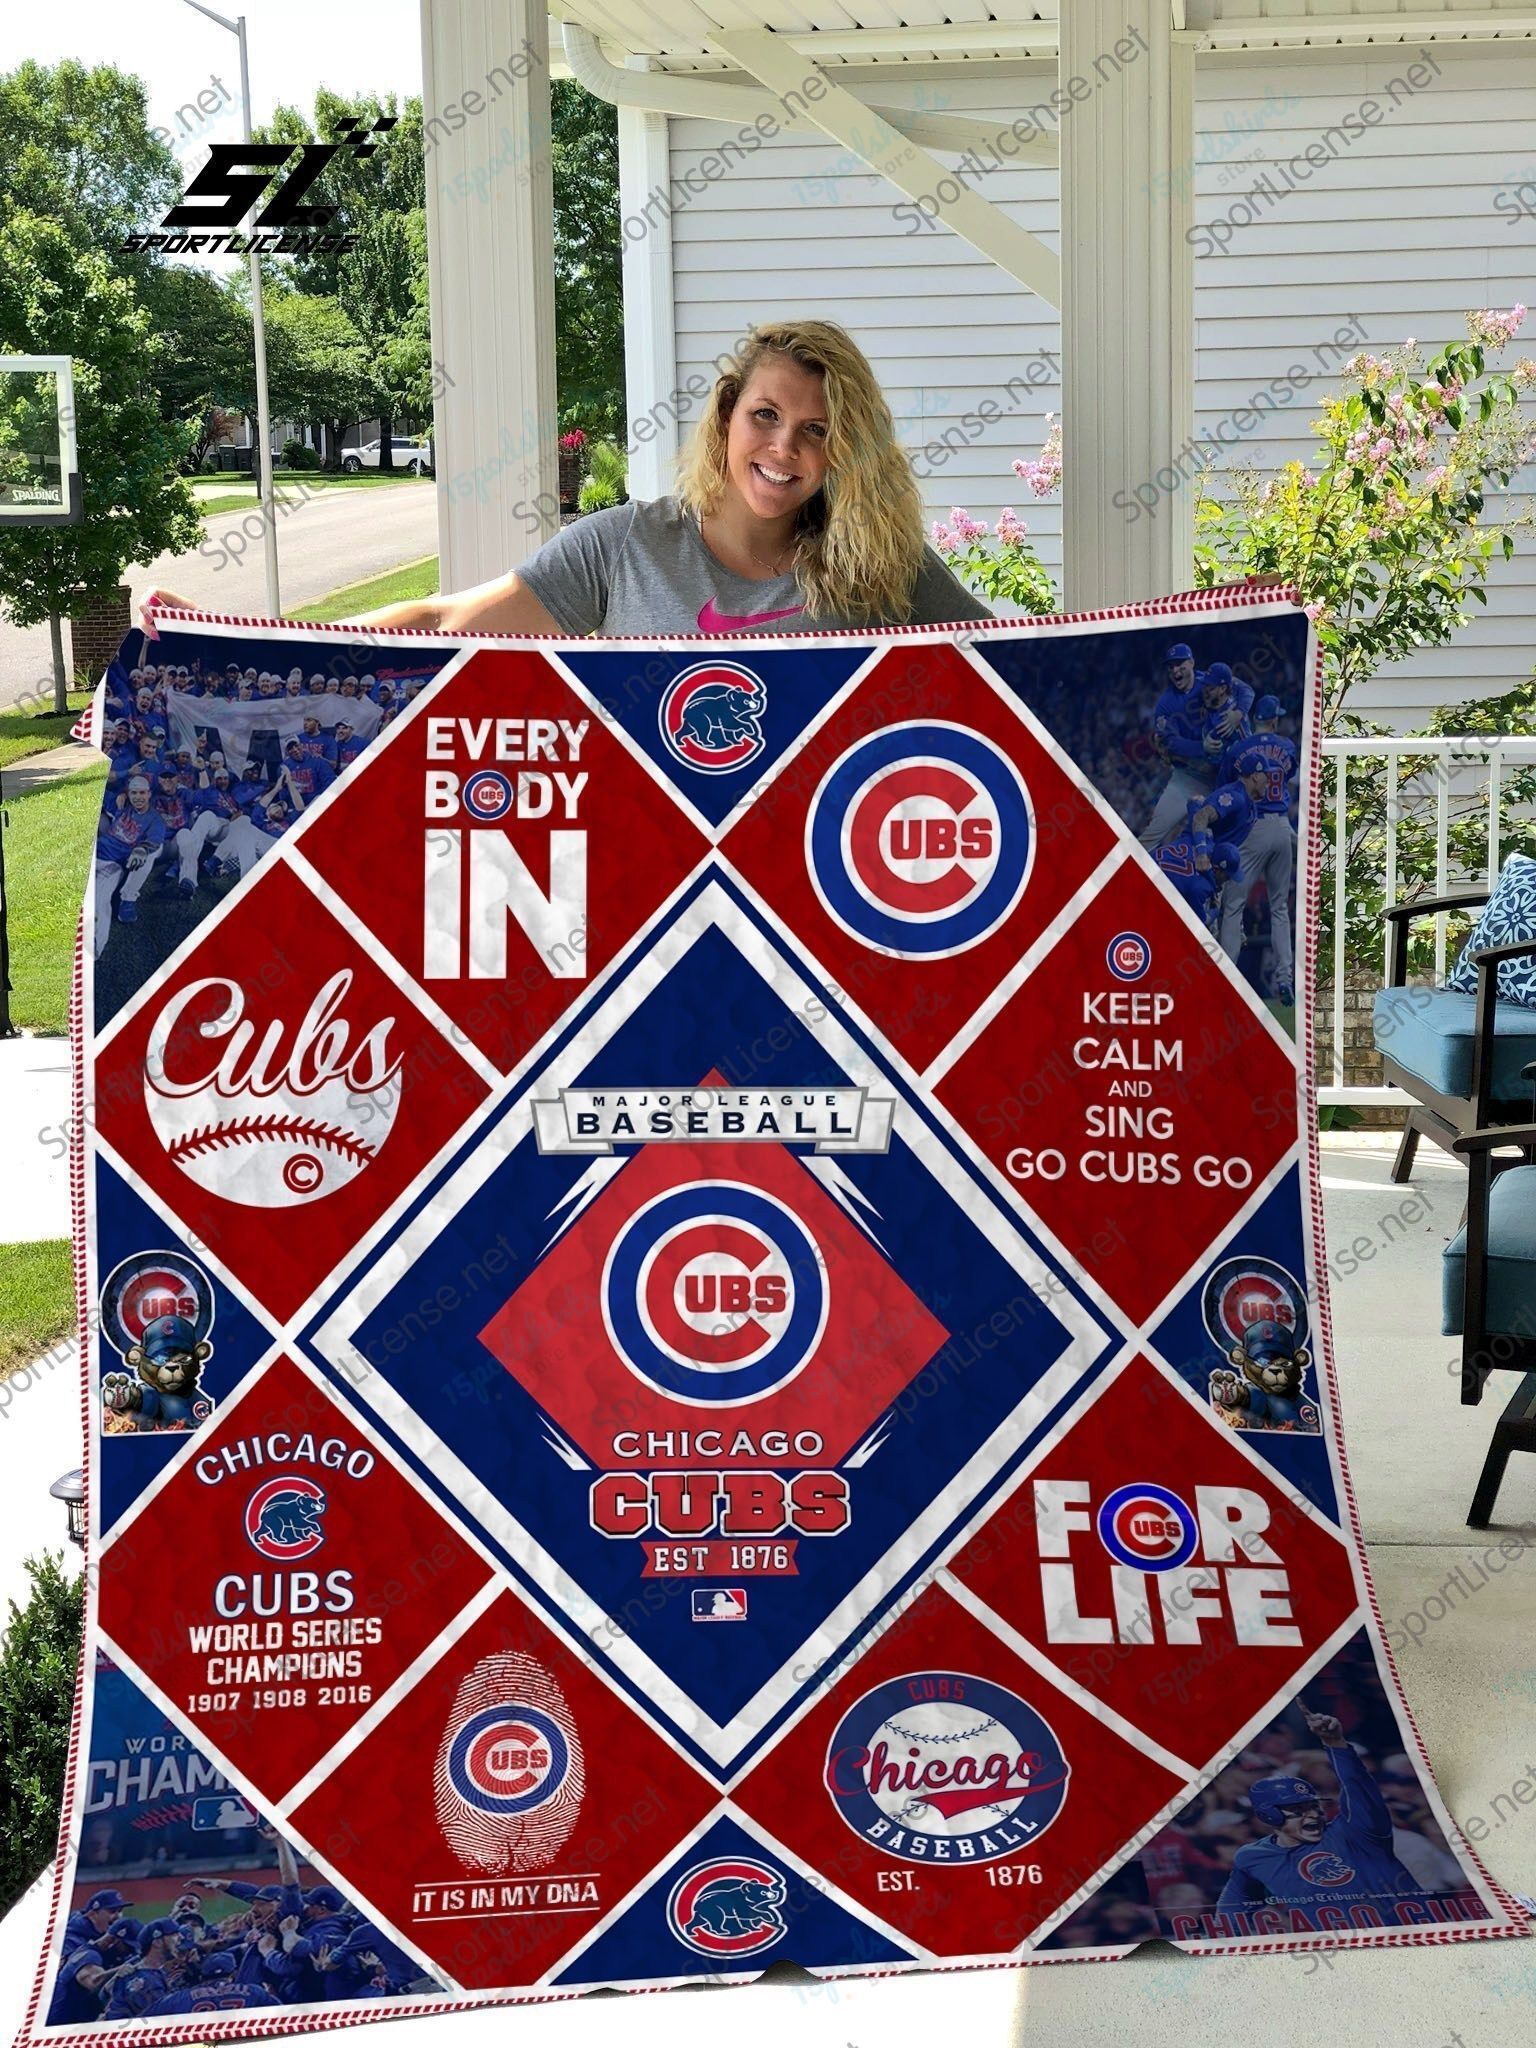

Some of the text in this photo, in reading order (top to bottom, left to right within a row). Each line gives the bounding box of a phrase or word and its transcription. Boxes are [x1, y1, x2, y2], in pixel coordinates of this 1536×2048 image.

[12, 489, 62, 502] SPALDING
[426, 717, 589, 762] EVERY
[424, 829, 588, 979] IN
[1083, 992, 1175, 1026] KEEP
[144, 967, 405, 1099] Cubs
[1073, 1037, 1183, 1072] CALM
[592, 1095, 838, 1108] MAJOR LEAGUE
[1108, 1080, 1153, 1098] AND
[576, 1110, 853, 1135] BASEBALL
[1085, 1105, 1175, 1140] SING
[1005, 1147, 1253, 1190] GO CUBS GO
[194, 1431, 376, 1486] CHICAGO
[611, 1429, 825, 1459] CHICAGO
[588, 1470, 852, 1539] CUBS
[653, 1545, 790, 1571] EST 1876
[214, 1568, 355, 1619] CUBS
[1039, 1562, 1304, 1647] LIFE
[188, 1617, 384, 1654] WORLD SERIES
[206, 1650, 363, 1686] CHAMPIONS
[187, 1685, 373, 1714] 1907 1908 2016
[907, 1679, 965, 1701] CUBS
[84, 1753, 236, 1815] CHAM
[826, 1741, 1060, 1803] Chicago
[866, 1816, 1039, 1859] BASEBALL
[877, 1865, 1044, 1892] EST. 1876
[412, 1881, 600, 1913] IT IS IN MY DNA
[1265, 1895, 1314, 1906] Chicago
[1315, 1892, 1365, 1903] Tribune
